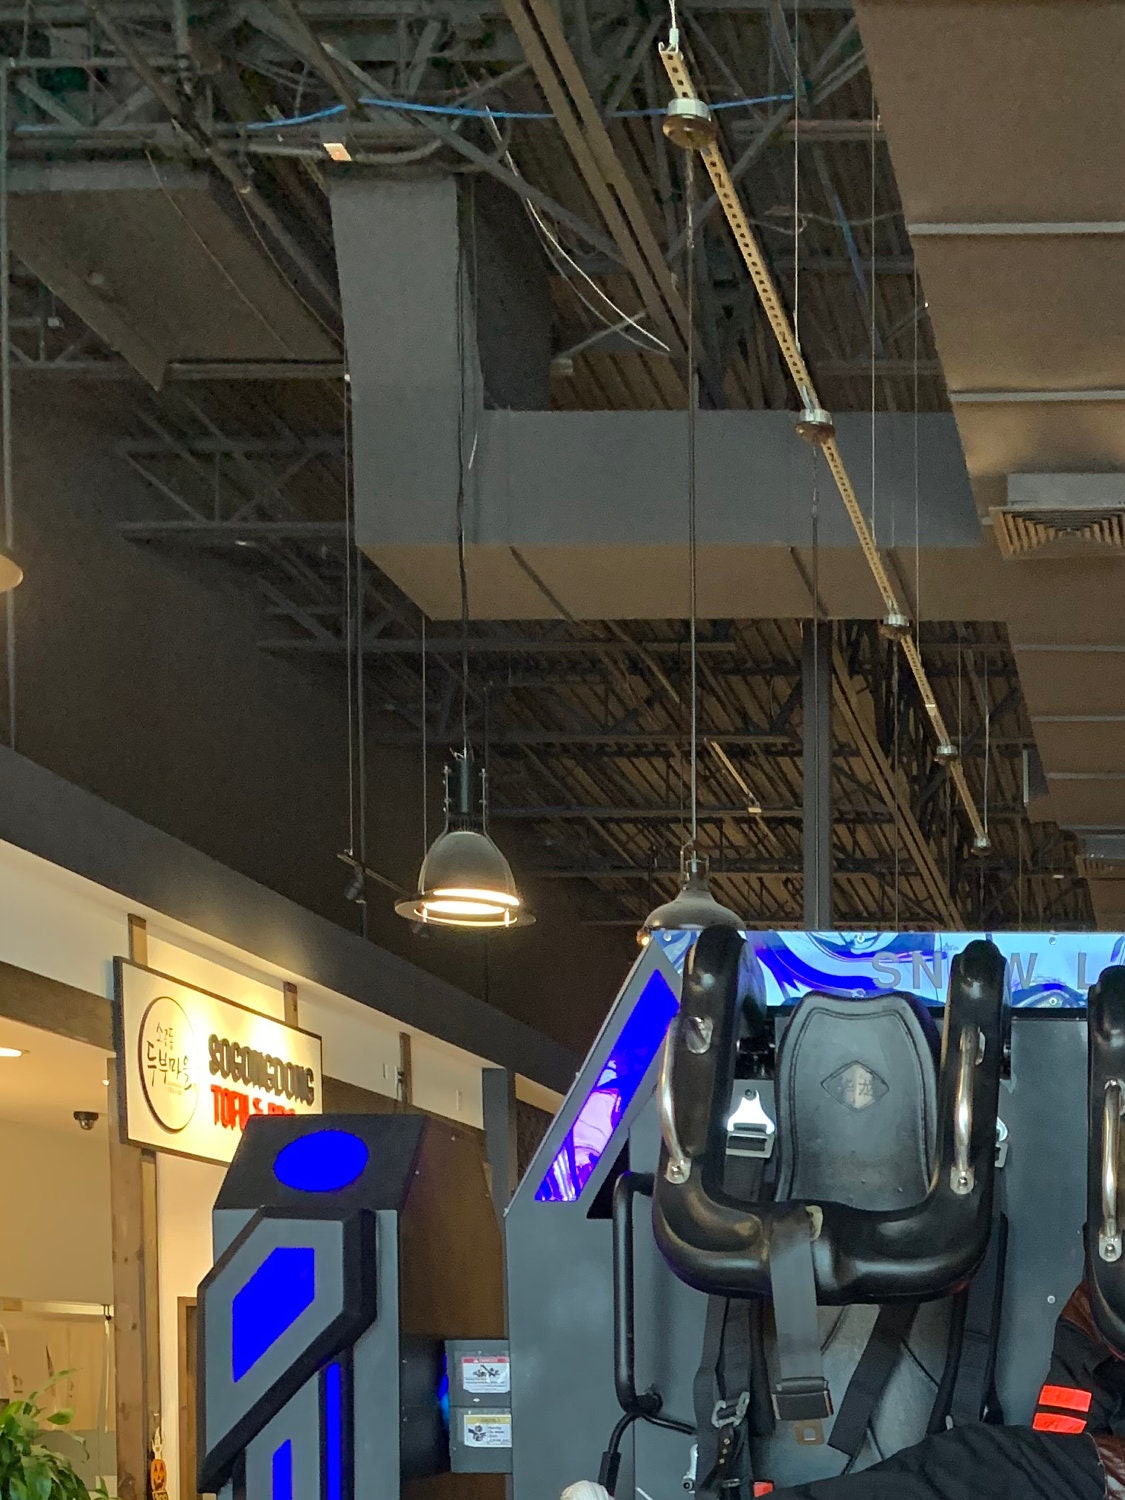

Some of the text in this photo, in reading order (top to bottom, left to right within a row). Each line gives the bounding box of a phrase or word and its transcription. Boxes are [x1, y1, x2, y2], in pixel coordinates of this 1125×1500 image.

[871, 951, 1037, 989] SNW
[147, 1039, 193, 1091] 두부마을
[208, 1033, 315, 1107] SOGONGDONG
[210, 1083, 249, 1132] TOFU
